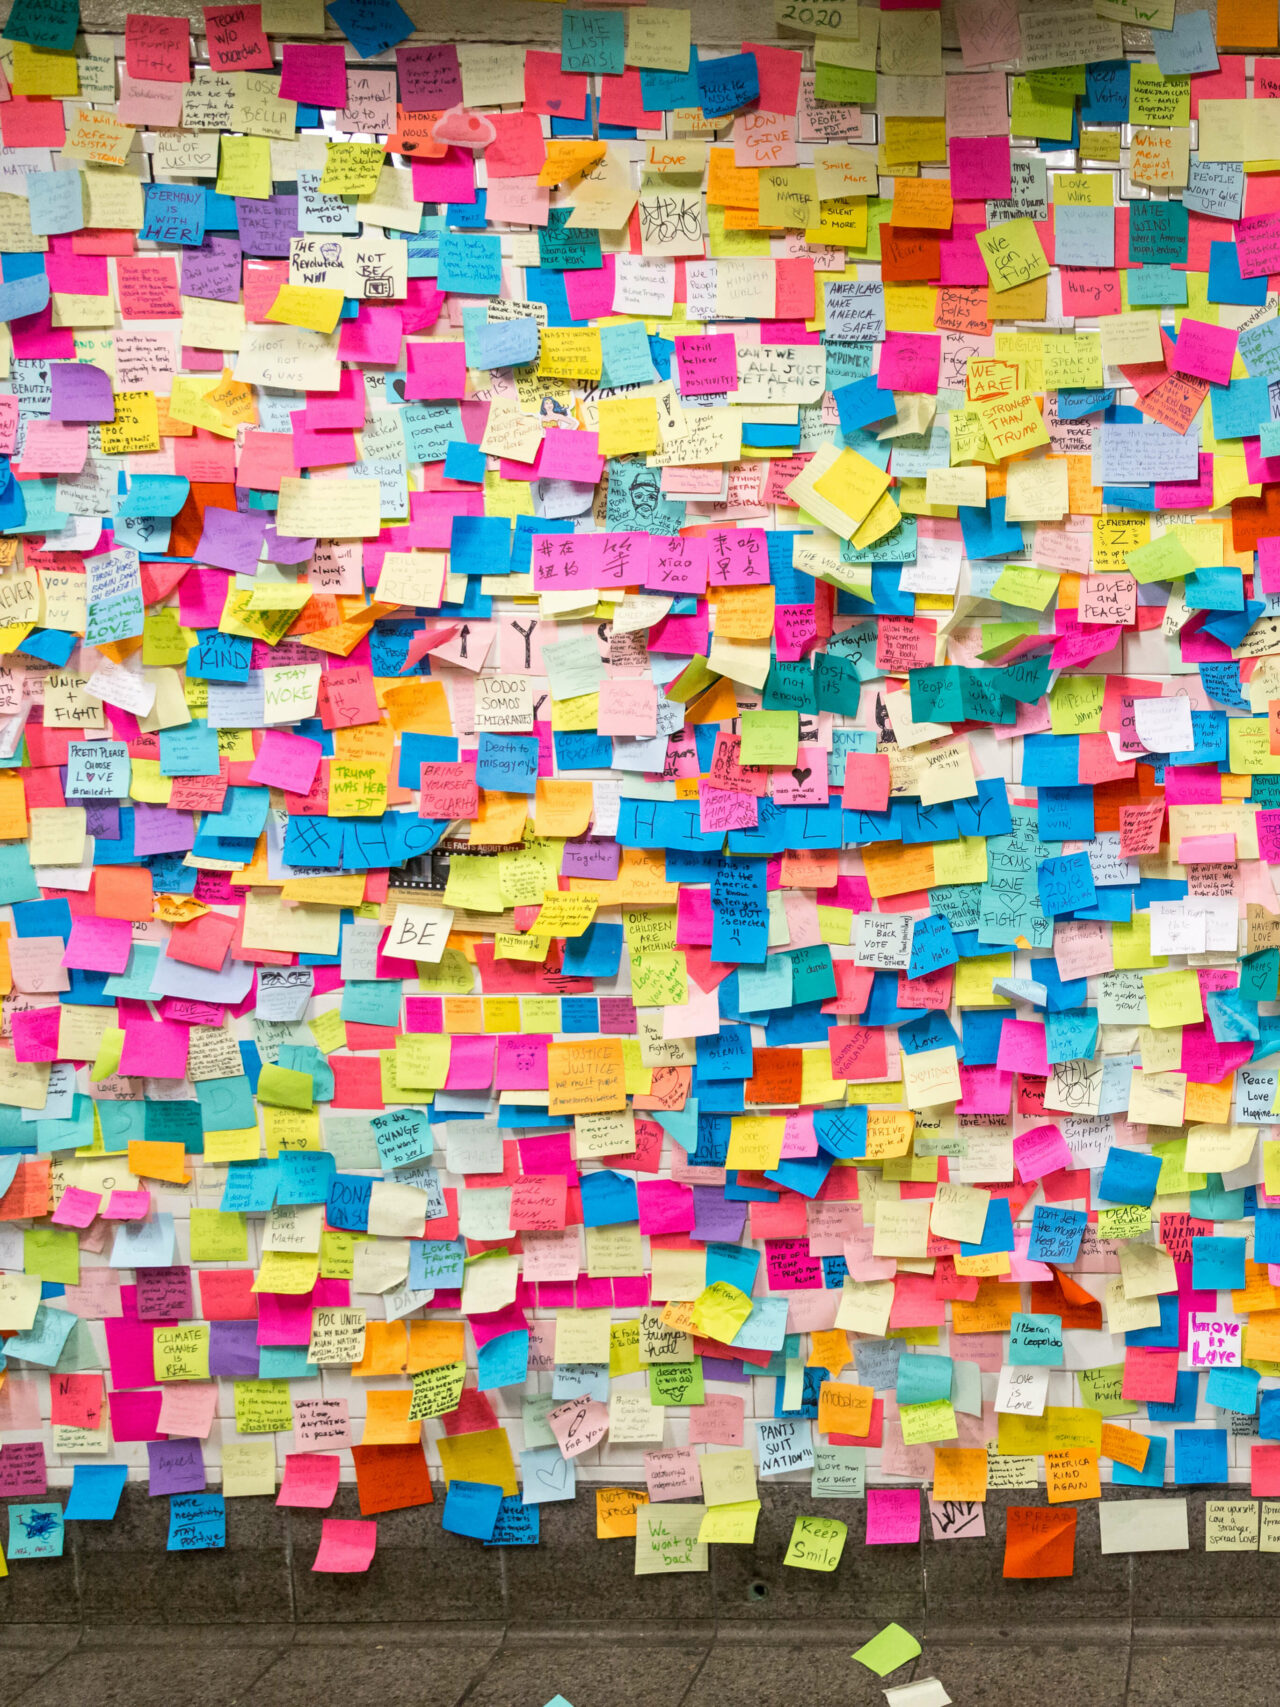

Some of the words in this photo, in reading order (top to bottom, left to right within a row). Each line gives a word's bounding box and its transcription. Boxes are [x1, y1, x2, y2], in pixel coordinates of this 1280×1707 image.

[781, 5, 842, 28] 2020
[569, 15, 604, 33] THE
[568, 34, 606, 49] LAST
[567, 51, 615, 70] DAYS!
[1095, 90, 1127, 107] Voting
[242, 107, 287, 124] BELLA
[746, 132, 789, 146] GIVE
[1135, 136, 1172, 149] White
[158, 142, 179, 152] ALL
[183, 142, 200, 152] OF
[755, 145, 782, 161] UP
[769, 176, 788, 187] YOU
[1059, 178, 1091, 190] Love
[146, 190, 201, 206] GERMANY
[777, 192, 812, 203] MATTER
[1067, 190, 1091, 203] Wins
[1219, 190, 1239, 201] GIVE
[1133, 202, 1164, 217] HATE
[156, 216, 187, 226] WITH
[145, 225, 200, 241] HER!
[295, 240, 316, 255] THE
[985, 235, 1010, 254] We
[356, 253, 383, 265] NOT
[357, 264, 381, 276] BE
[775, 348, 795, 360] WE
[261, 368, 305, 382] GUNS
[749, 362, 778, 373] ALL
[783, 364, 823, 376] JUST
[970, 364, 996, 379] WE
[974, 375, 1012, 394] ARE
[982, 394, 1034, 420] STRONGER
[989, 412, 1025, 430] THAN
[993, 422, 1038, 446] TRUMP
[1097, 518, 1146, 530] GENERATION
[312, 565, 346, 576] always
[1097, 592, 1118, 604] and
[1084, 603, 1126, 619] PEACE
[87, 620, 132, 641] LOVE
[200, 647, 248, 669] KIND
[274, 668, 307, 682] STAY
[481, 678, 526, 694] TODOS
[917, 678, 953, 695] People
[266, 686, 313, 705] WOKE
[481, 696, 520, 709] SOMOS
[772, 689, 811, 707] enough
[54, 705, 100, 720] FIGHT
[475, 712, 533, 727] IMIGRANTES
[70, 745, 99, 758] PRETTY
[100, 747, 125, 758] PLEASE
[484, 741, 512, 753] Death
[85, 760, 112, 770] CHOOSE
[335, 765, 376, 779] TRUMP
[334, 782, 360, 794] WAS
[425, 778, 473, 791] YOURSELF
[566, 852, 612, 863] Together
[990, 877, 1023, 891] LOVE
[629, 912, 650, 923] OUR
[984, 912, 1024, 929] FIGHT
[396, 918, 434, 945] BE
[629, 921, 672, 933] CHILDREN
[864, 921, 893, 930] FIGHT
[640, 933, 660, 943] ARE
[864, 940, 889, 949] VOTE
[633, 941, 678, 953] WATCHING
[708, 1046, 747, 1057] BERNIE
[562, 1061, 615, 1076] JUSTICE
[1241, 1072, 1274, 1086] Peace
[377, 1123, 421, 1144] CHANGE
[271, 1219, 296, 1231] Lives
[271, 1232, 306, 1244] Matter
[422, 1264, 460, 1278] HATE
[337, 1313, 363, 1326] UNITE
[156, 1330, 202, 1345] CLIMATE
[163, 1344, 199, 1356] CHANGE
[761, 1424, 795, 1440] PANTS
[766, 1440, 792, 1455] SUIT
[1050, 1458, 1090, 1470] AMERICA
[1053, 1470, 1080, 1480] KIND
[1053, 1480, 1088, 1492] AGAIN
[663, 1551, 693, 1565] back
